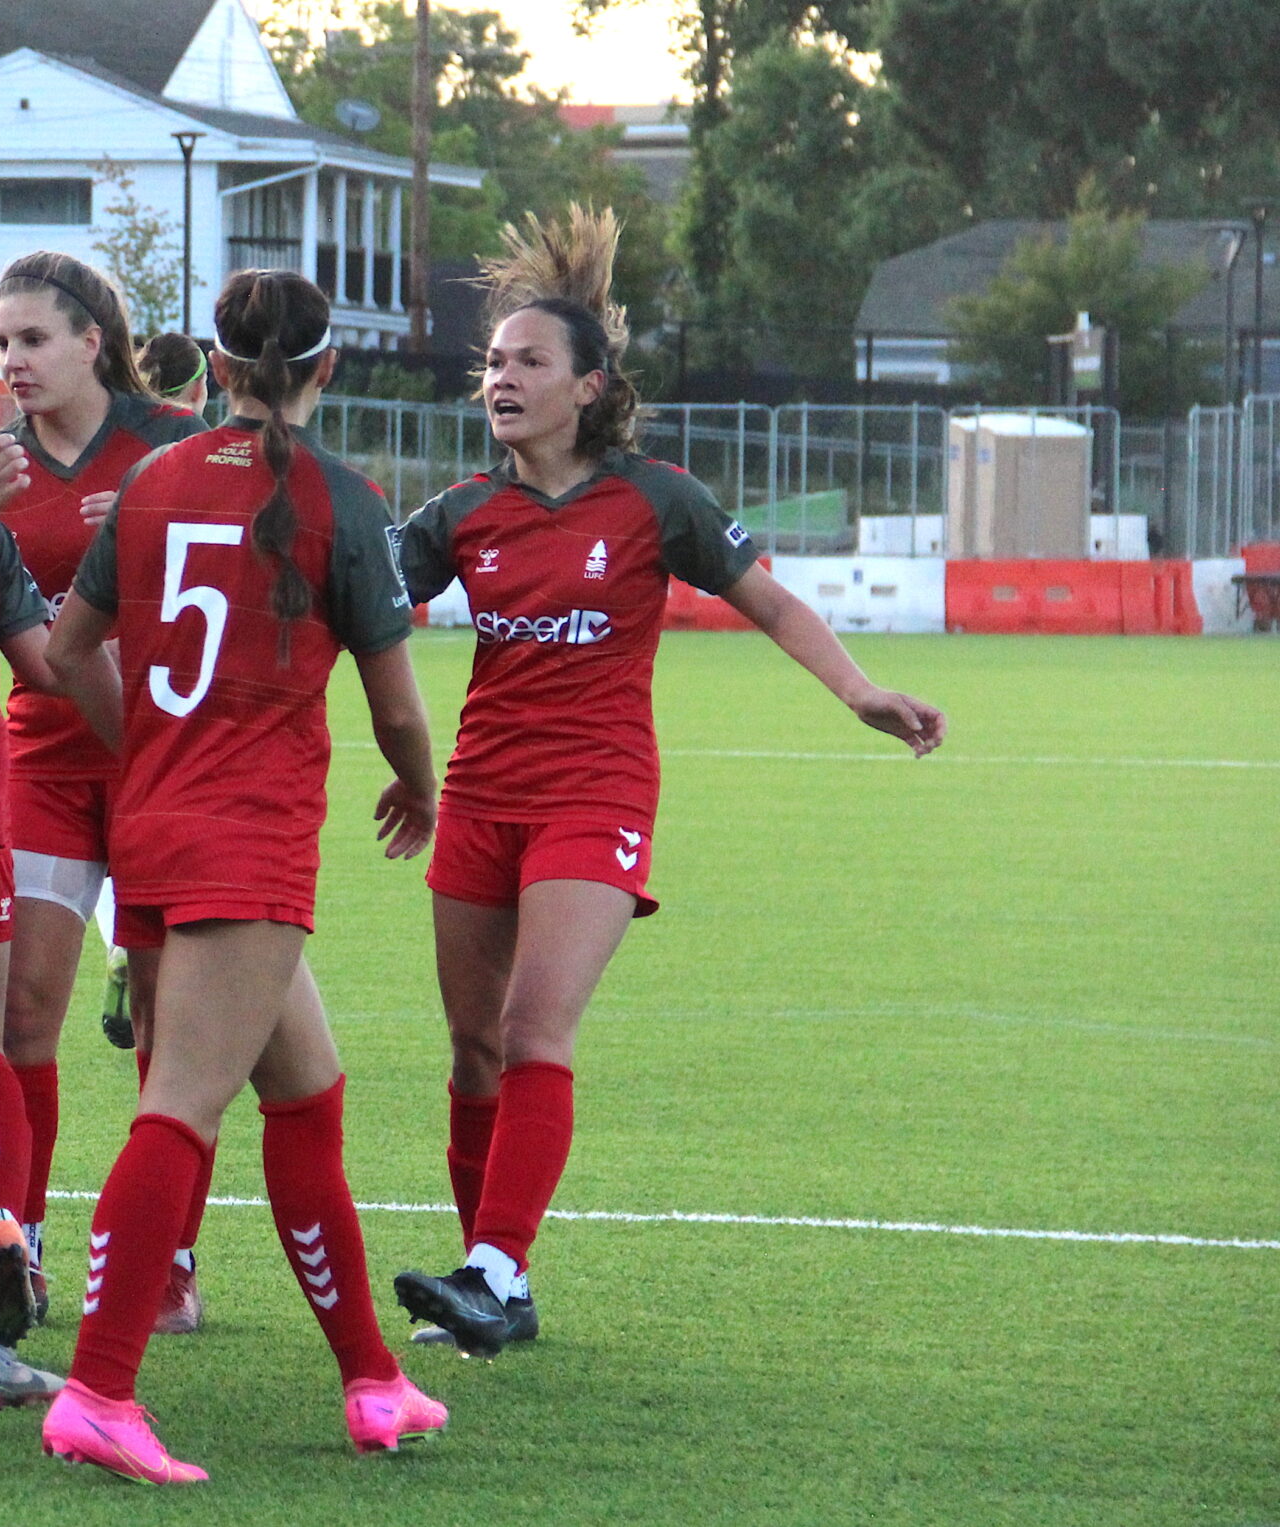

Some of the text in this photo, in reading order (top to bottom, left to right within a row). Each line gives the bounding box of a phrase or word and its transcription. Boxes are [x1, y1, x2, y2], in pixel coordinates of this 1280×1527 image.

[584, 572, 604, 580] LUFC
[149, 522, 245, 718] 5
[476, 609, 612, 645] SheerID
